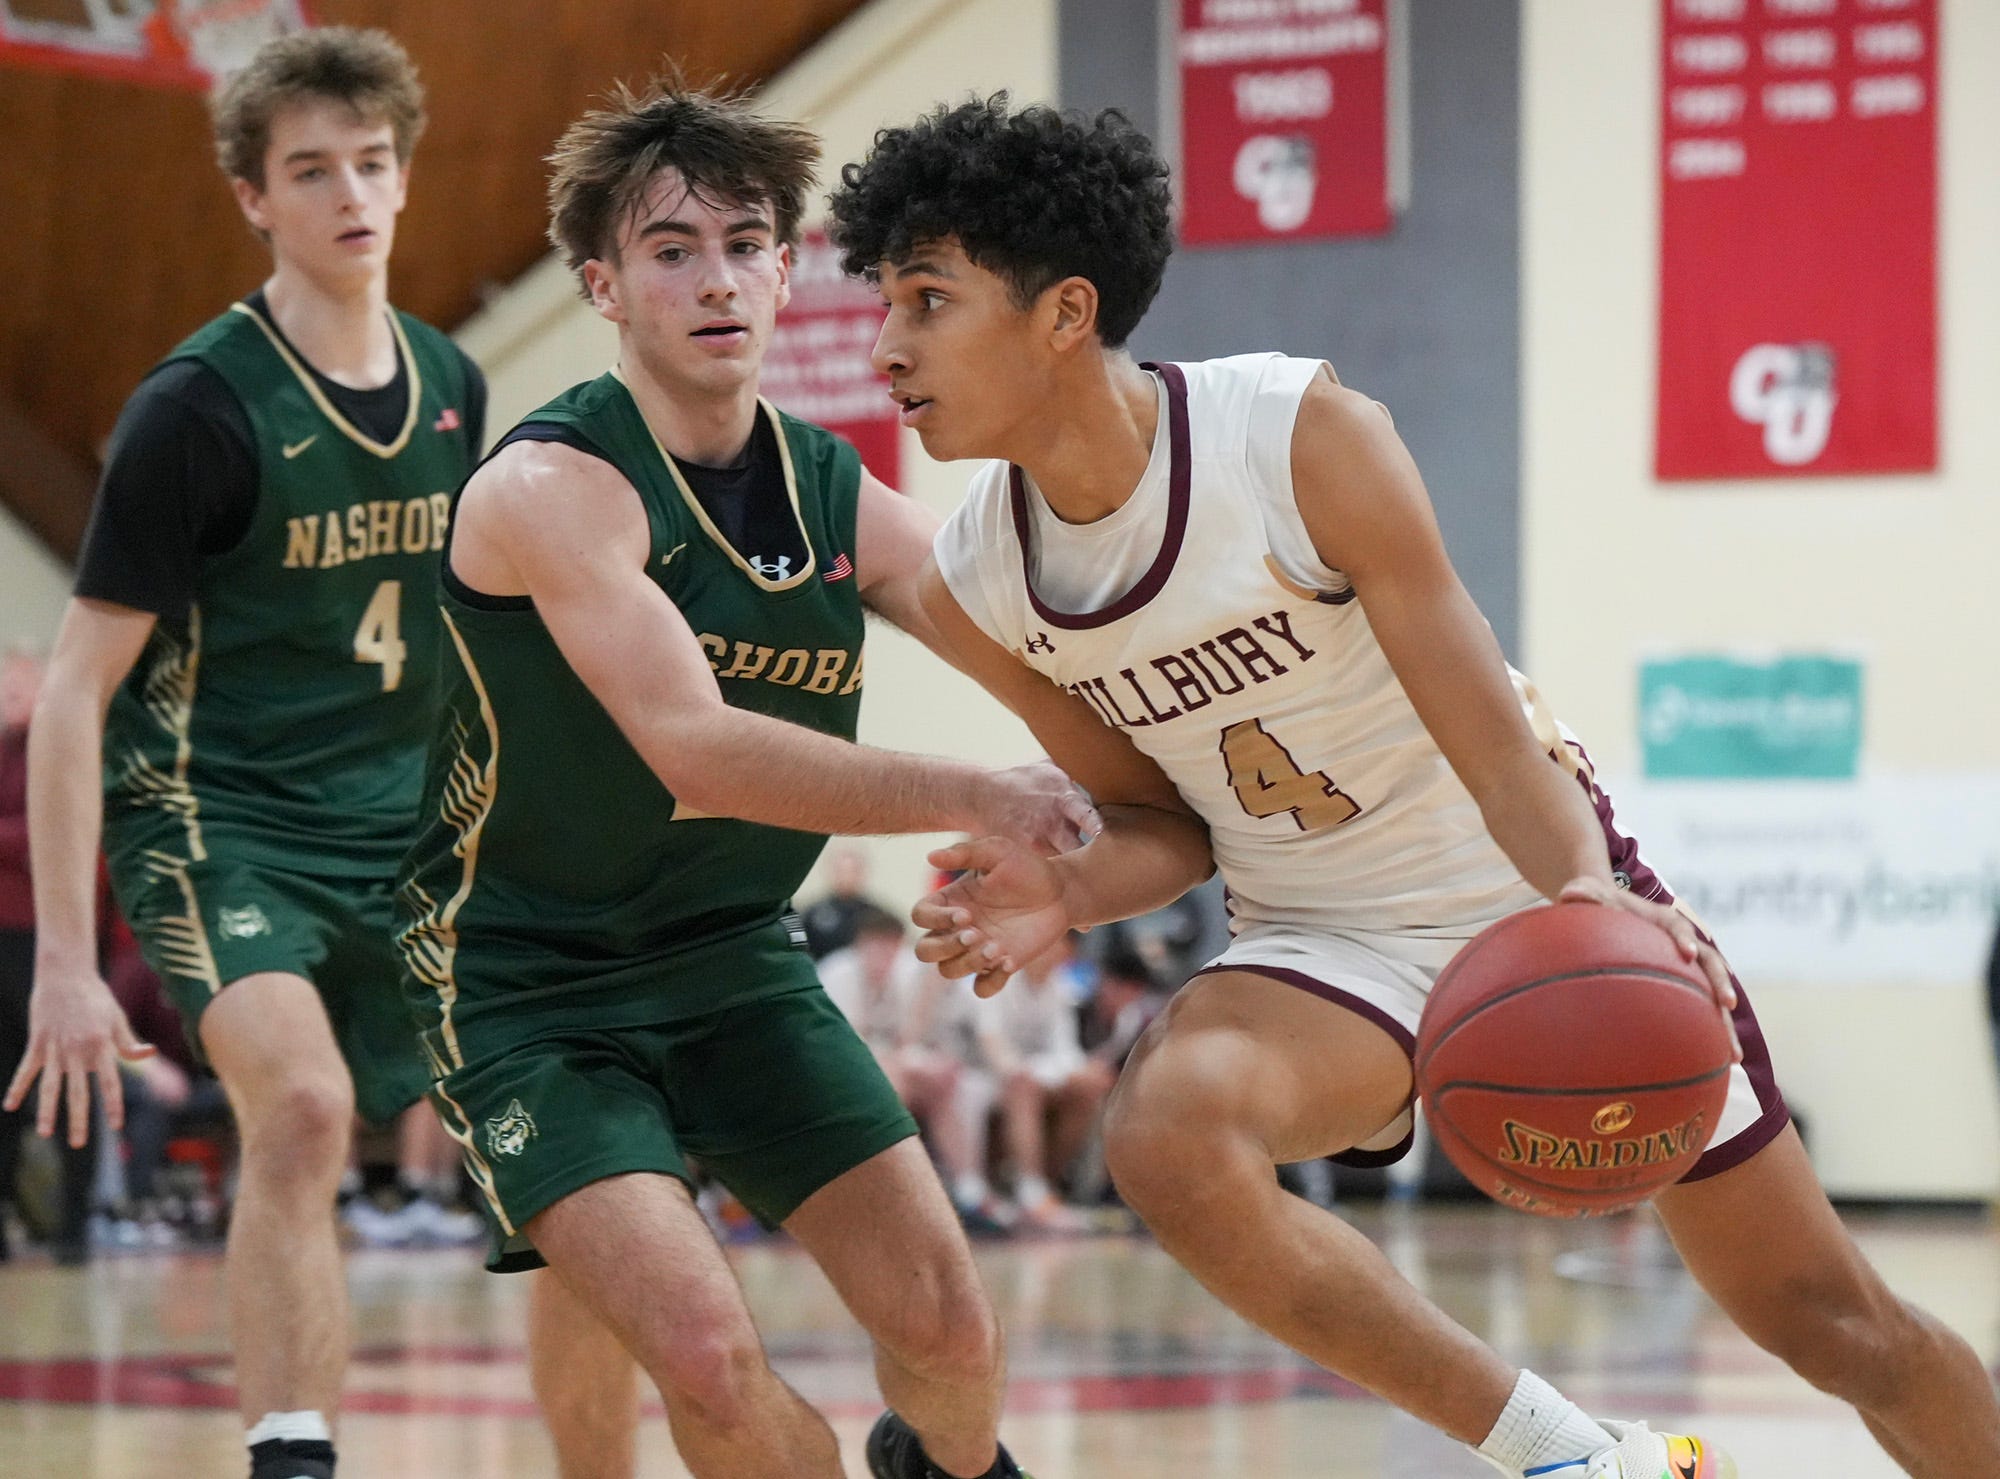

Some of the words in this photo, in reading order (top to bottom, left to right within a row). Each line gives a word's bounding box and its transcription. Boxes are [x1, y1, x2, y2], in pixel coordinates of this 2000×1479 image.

[353, 579, 407, 692] 4
[1219, 717, 1362, 831] 4
[1500, 1109, 1706, 1170] SPALDING
